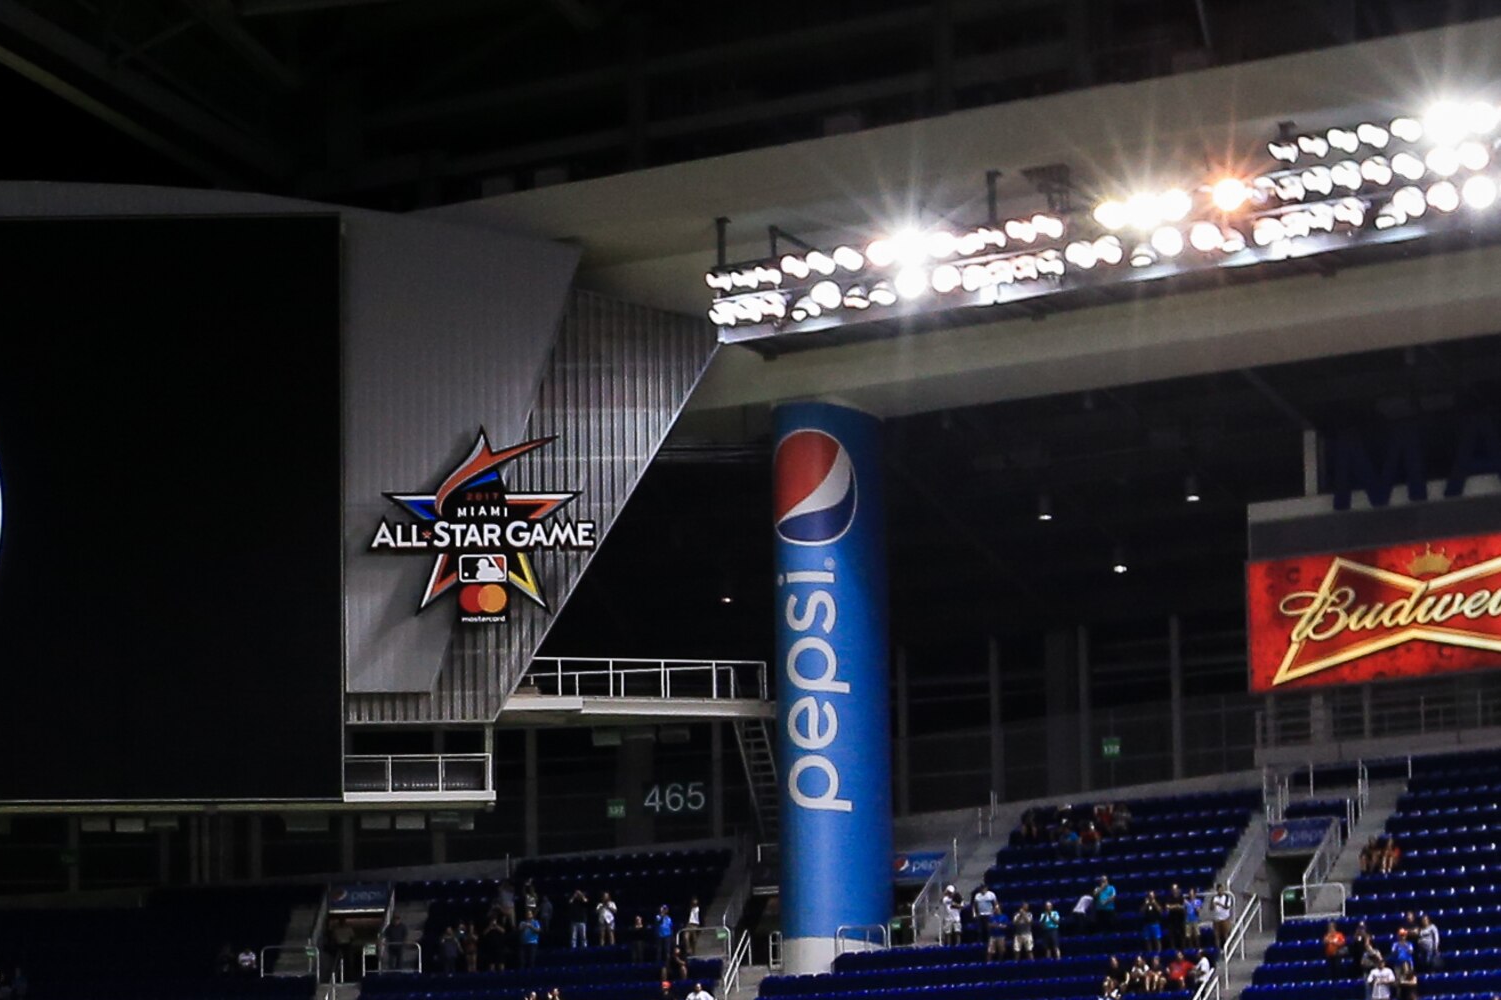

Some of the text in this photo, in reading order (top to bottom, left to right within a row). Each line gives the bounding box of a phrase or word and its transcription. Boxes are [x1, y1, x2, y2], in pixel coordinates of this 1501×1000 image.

[457, 506, 509, 518] MIAMI
[505, 521, 595, 548] GAME
[777, 566, 854, 812] pepsi
[643, 781, 706, 813] 465
